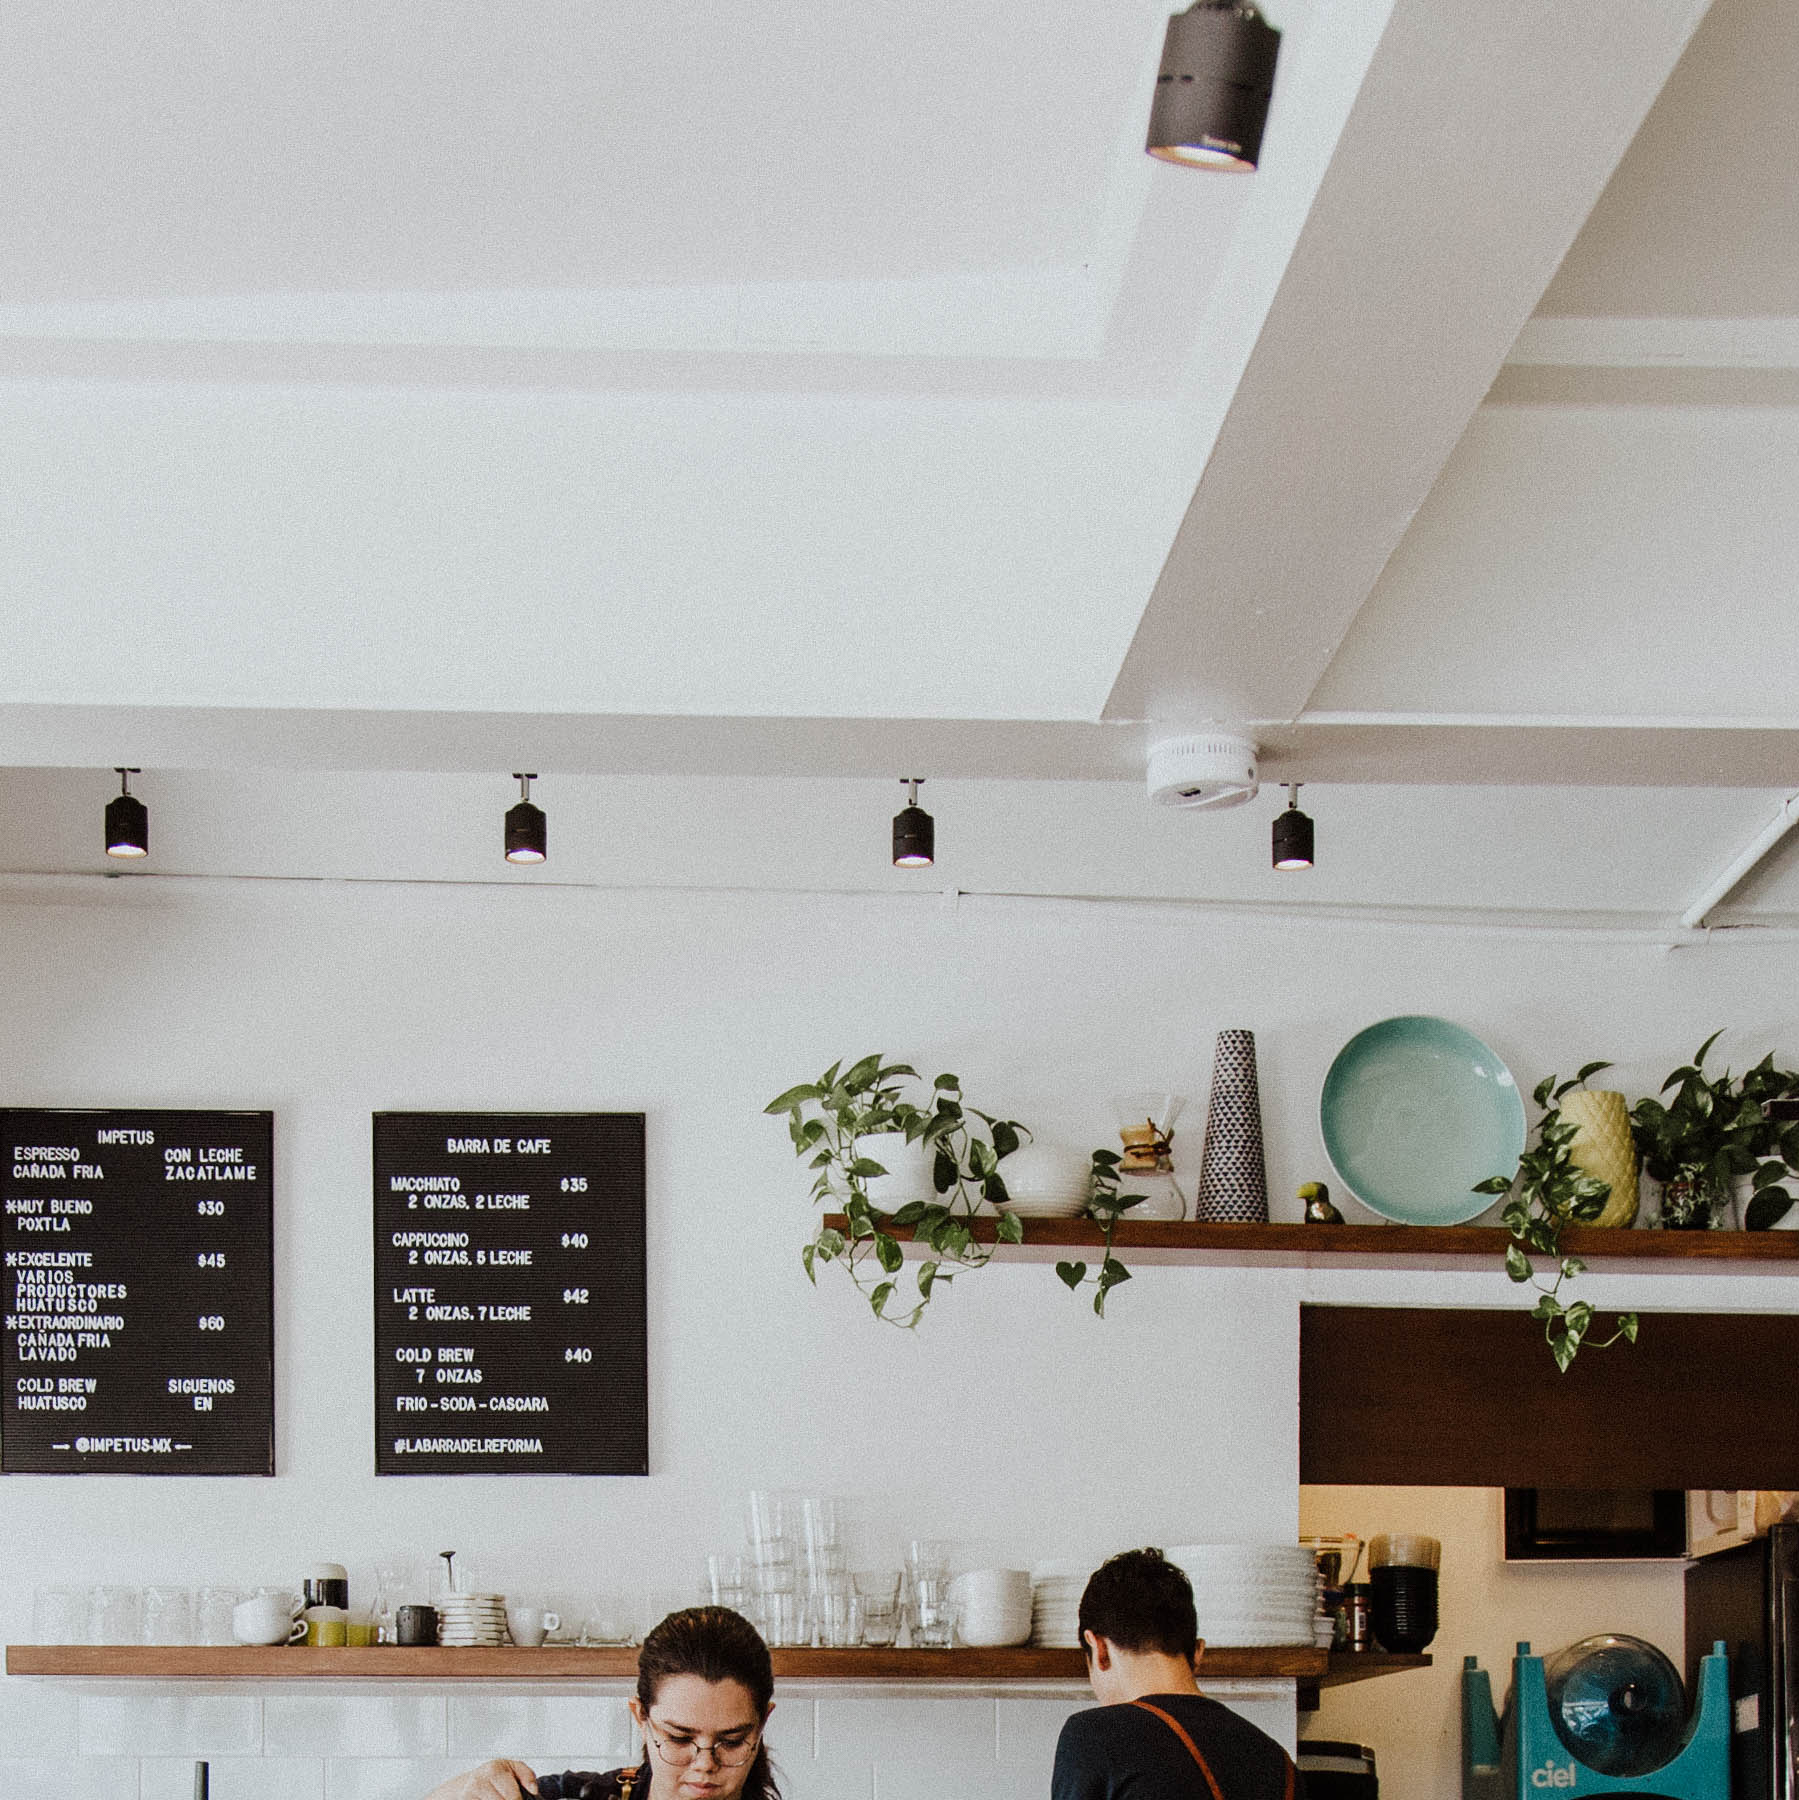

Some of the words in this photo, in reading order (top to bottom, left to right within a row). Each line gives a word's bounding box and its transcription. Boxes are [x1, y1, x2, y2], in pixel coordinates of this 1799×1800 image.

[98, 1130, 154, 1145] IMPETUS
[448, 1139, 490, 1153] BARRA
[494, 1139, 511, 1153] DE
[517, 1139, 551, 1153] CAFE
[15, 1147, 80, 1161] ESPRESSO
[165, 1148, 191, 1162] CON
[200, 1149, 243, 1163] LECHE
[13, 1163, 66, 1178] CAÑADA
[74, 1165, 103, 1179] FRIA
[166, 1166, 256, 1180] ZACATLAME
[391, 1177, 460, 1192] MACCHIATO
[561, 1178, 587, 1192] $35
[51, 1200, 92, 1214] BUENO
[198, 1201, 224, 1215] $30
[408, 1194, 417, 1209] 2
[475, 1195, 485, 1209] 2
[488, 1195, 530, 1209] LECHE
[18, 1217, 70, 1231] POXTLA
[392, 1233, 469, 1247] CAPPUCCINO
[562, 1233, 588, 1248] $40
[198, 1253, 225, 1268] $45
[409, 1250, 418, 1264] 2
[477, 1250, 486, 1264] 5
[490, 1250, 532, 1265] LECHE
[17, 1270, 73, 1284] VARIOS
[17, 1284, 127, 1298] PRODUCTORES
[394, 1288, 435, 1303] LATTE
[563, 1288, 589, 1304] $42
[17, 1298, 97, 1312] HUATUSCO
[409, 1306, 418, 1320] 2
[478, 1306, 487, 1320] 7
[489, 1306, 531, 1320] LECHE
[199, 1316, 224, 1331] $60
[18, 1330, 74, 1347] CAÑADA
[78, 1333, 111, 1347] FRIA
[19, 1347, 77, 1361] LAVADO
[396, 1348, 432, 1362] COLD
[438, 1348, 474, 1362] BREW
[565, 1348, 592, 1362] $40
[416, 1369, 425, 1383] 7
[436, 1369, 482, 1383] ONZAS
[17, 1378, 53, 1393] COLD
[59, 1379, 96, 1393] BREW
[168, 1379, 235, 1393] SIGUENOS
[18, 1396, 86, 1410] HUATUSCO
[194, 1397, 212, 1411] EN
[490, 1397, 549, 1411] CASCARA
[395, 1439, 543, 1454] #LABARRADELREFORMA
[1531, 1760, 1576, 1788] ciel
